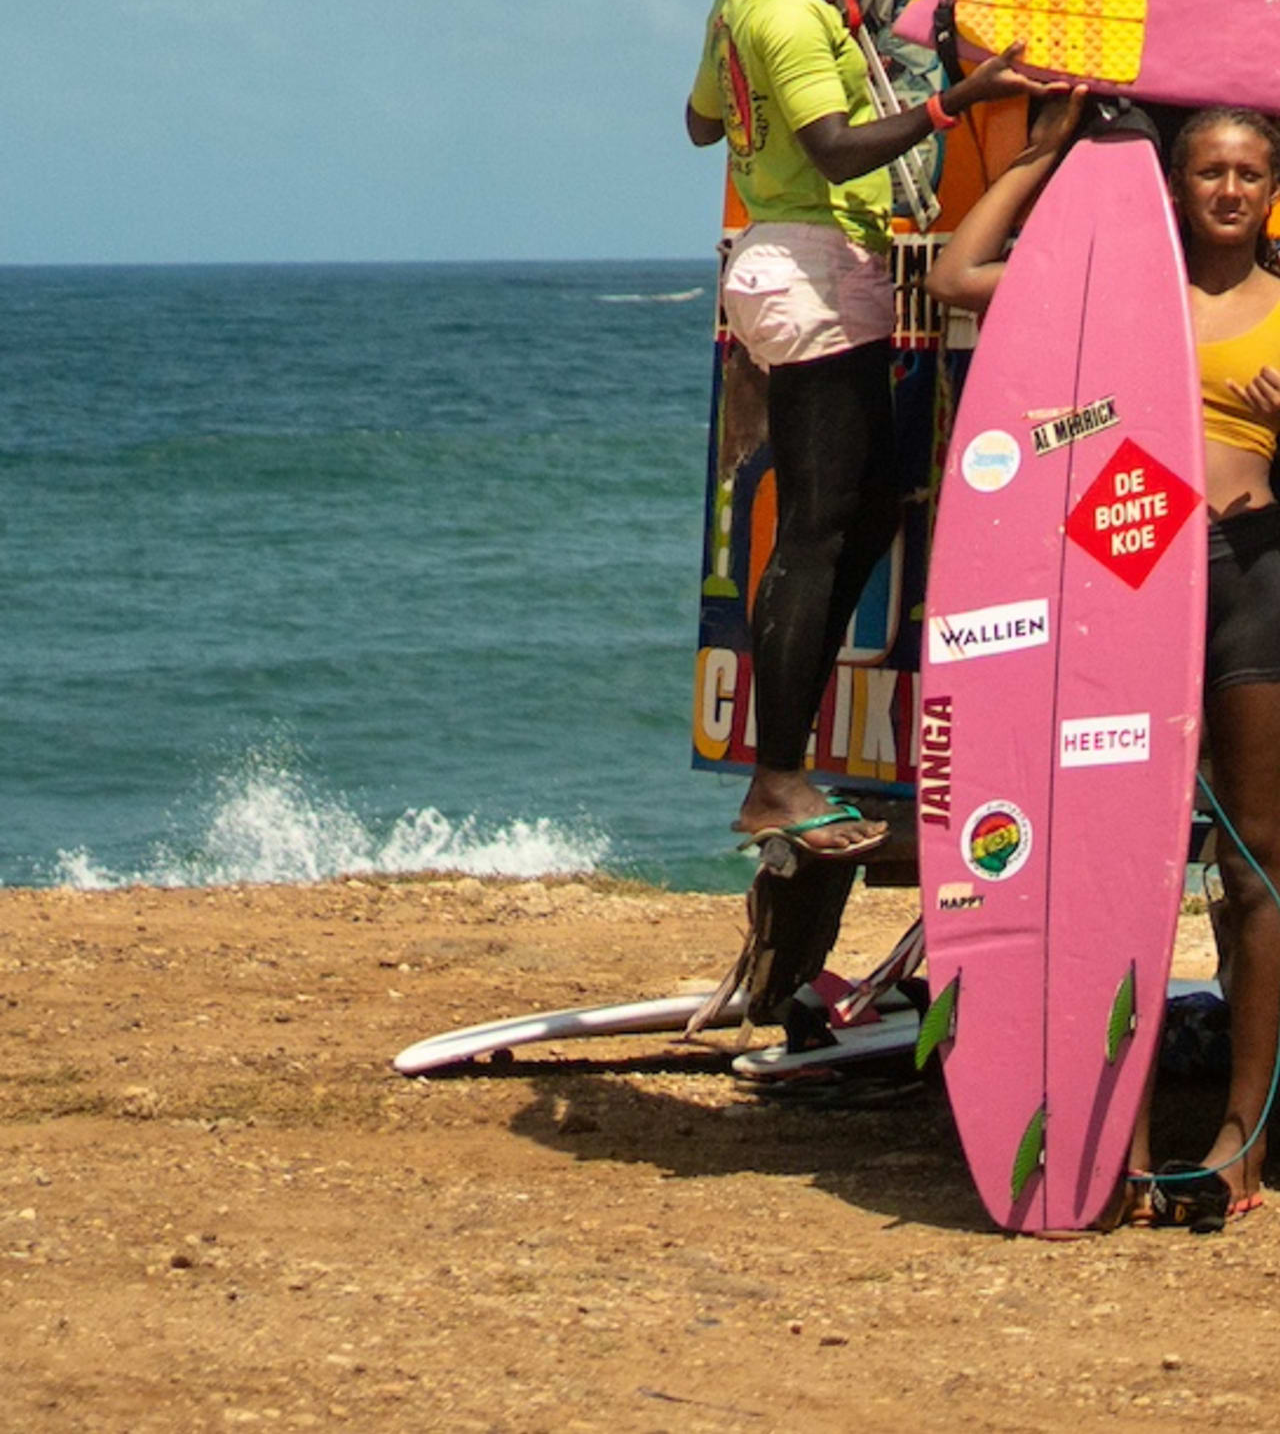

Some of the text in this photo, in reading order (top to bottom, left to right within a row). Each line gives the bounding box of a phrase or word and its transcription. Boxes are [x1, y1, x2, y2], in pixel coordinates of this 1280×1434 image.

[1053, 400, 1118, 438] MERRICK
[1115, 468, 1145, 497] DE
[1095, 491, 1169, 531] BONTE
[1111, 524, 1155, 556] KOE
[941, 615, 1045, 647] WALLIEN
[921, 695, 952, 831] JANGA
[939, 895, 986, 910] HAPPY
